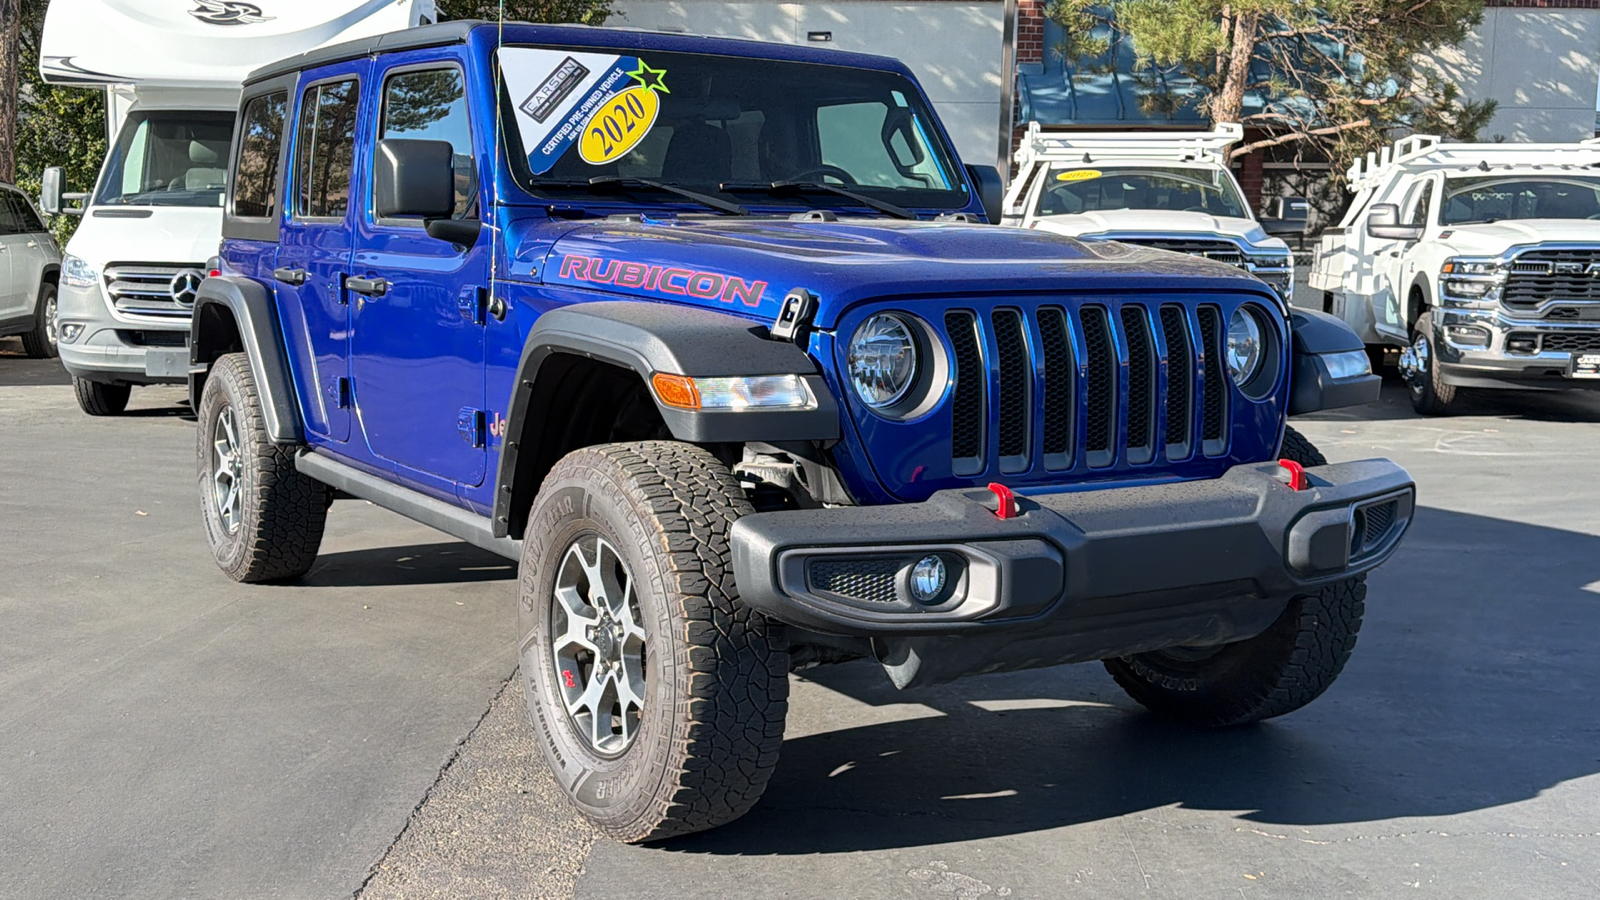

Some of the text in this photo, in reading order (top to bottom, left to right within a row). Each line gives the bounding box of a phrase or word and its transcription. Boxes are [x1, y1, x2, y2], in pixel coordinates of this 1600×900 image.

[526, 61, 576, 112] CARSON
[541, 122, 573, 155] CERTIFIED
[568, 89, 603, 126] PRE-OWNED
[598, 67, 625, 92] VEHICLE
[591, 92, 645, 157] 2020
[559, 254, 768, 308] RUBICON
[490, 412, 506, 437] Je
[529, 676, 538, 693] AT
[1120, 653, 1197, 691] WRANG
[533, 698, 566, 770] WORKHORSE
